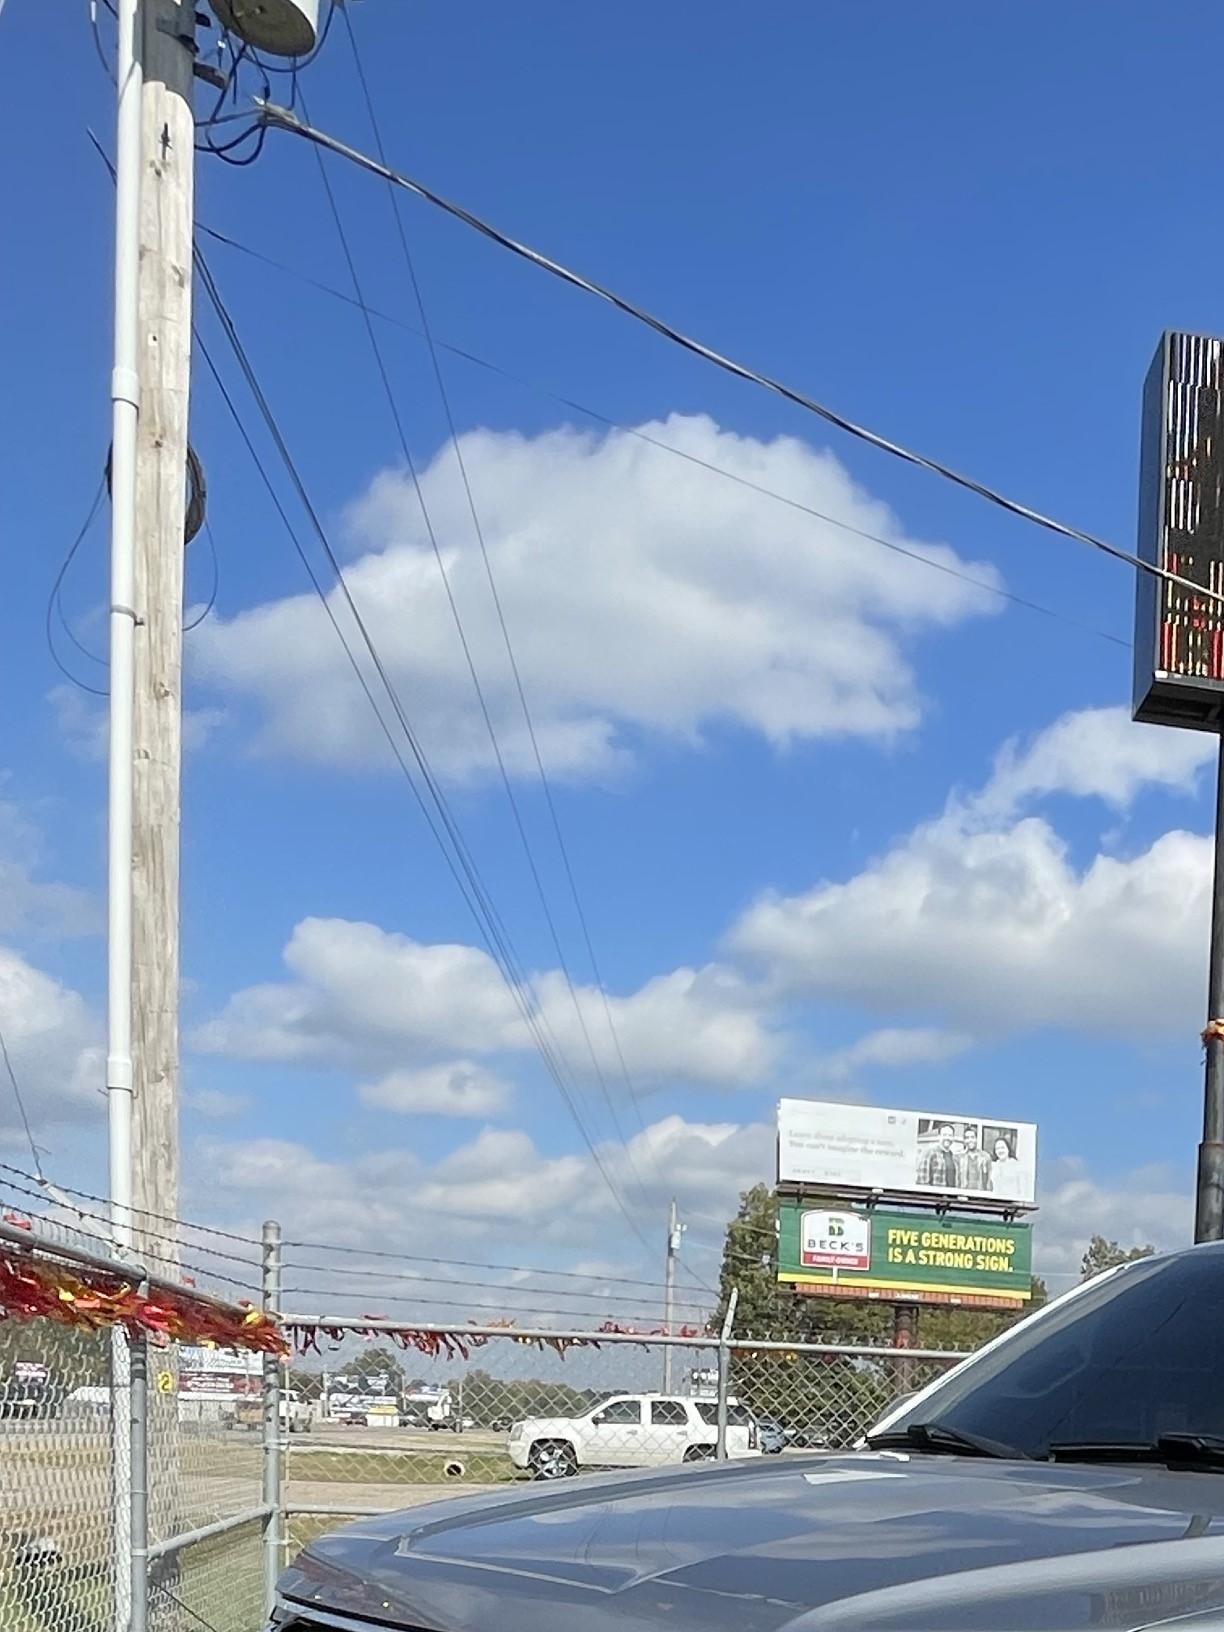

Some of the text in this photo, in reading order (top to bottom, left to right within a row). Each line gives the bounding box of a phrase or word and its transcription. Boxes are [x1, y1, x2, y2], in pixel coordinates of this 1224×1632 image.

[807, 1239, 864, 1252] BECK'S
[888, 1229, 1015, 1254] FIVE GENERATIONS
[888, 1247, 1014, 1272] IS A STRONG SIGN.
